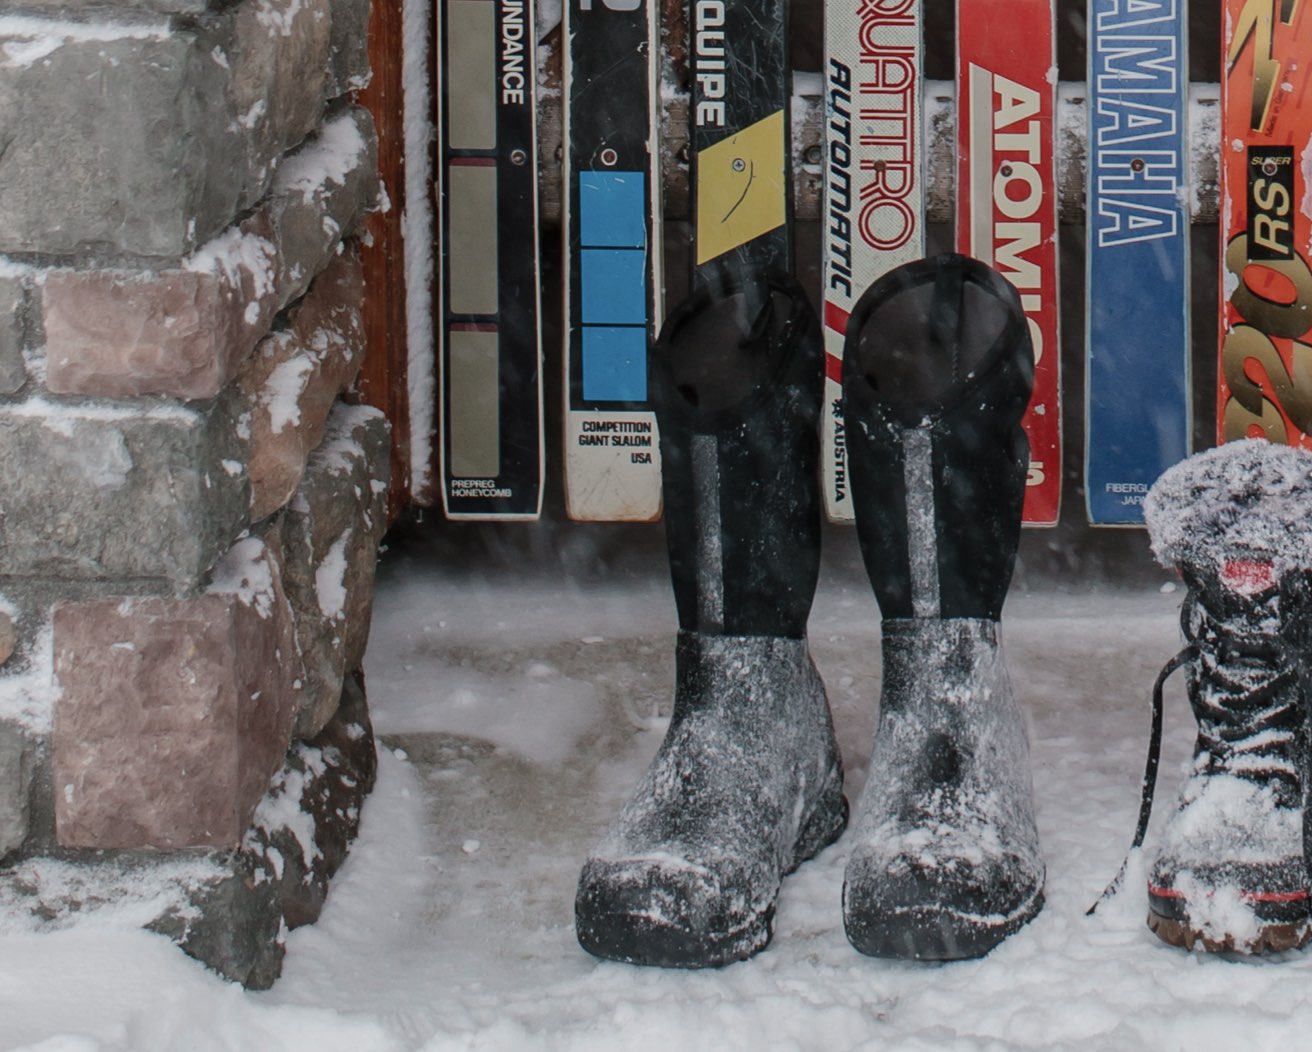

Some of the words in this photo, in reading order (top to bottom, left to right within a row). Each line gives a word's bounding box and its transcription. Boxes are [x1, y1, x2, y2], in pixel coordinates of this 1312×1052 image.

[696, 0, 725, 126] QUIPE
[830, 58, 851, 298] AUTOMATIC
[1253, 178, 1290, 255] RS
[582, 421, 652, 433] COMPETITION
[578, 434, 609, 446] GIANT
[611, 435, 652, 447] SLALOM
[631, 452, 652, 464] USA
[834, 421, 846, 503] AUSTRIA
[451, 480, 496, 489] PREPREG
[1105, 483, 1151, 493] FIBERGL
[451, 488, 513, 498] HONEYCOMB
